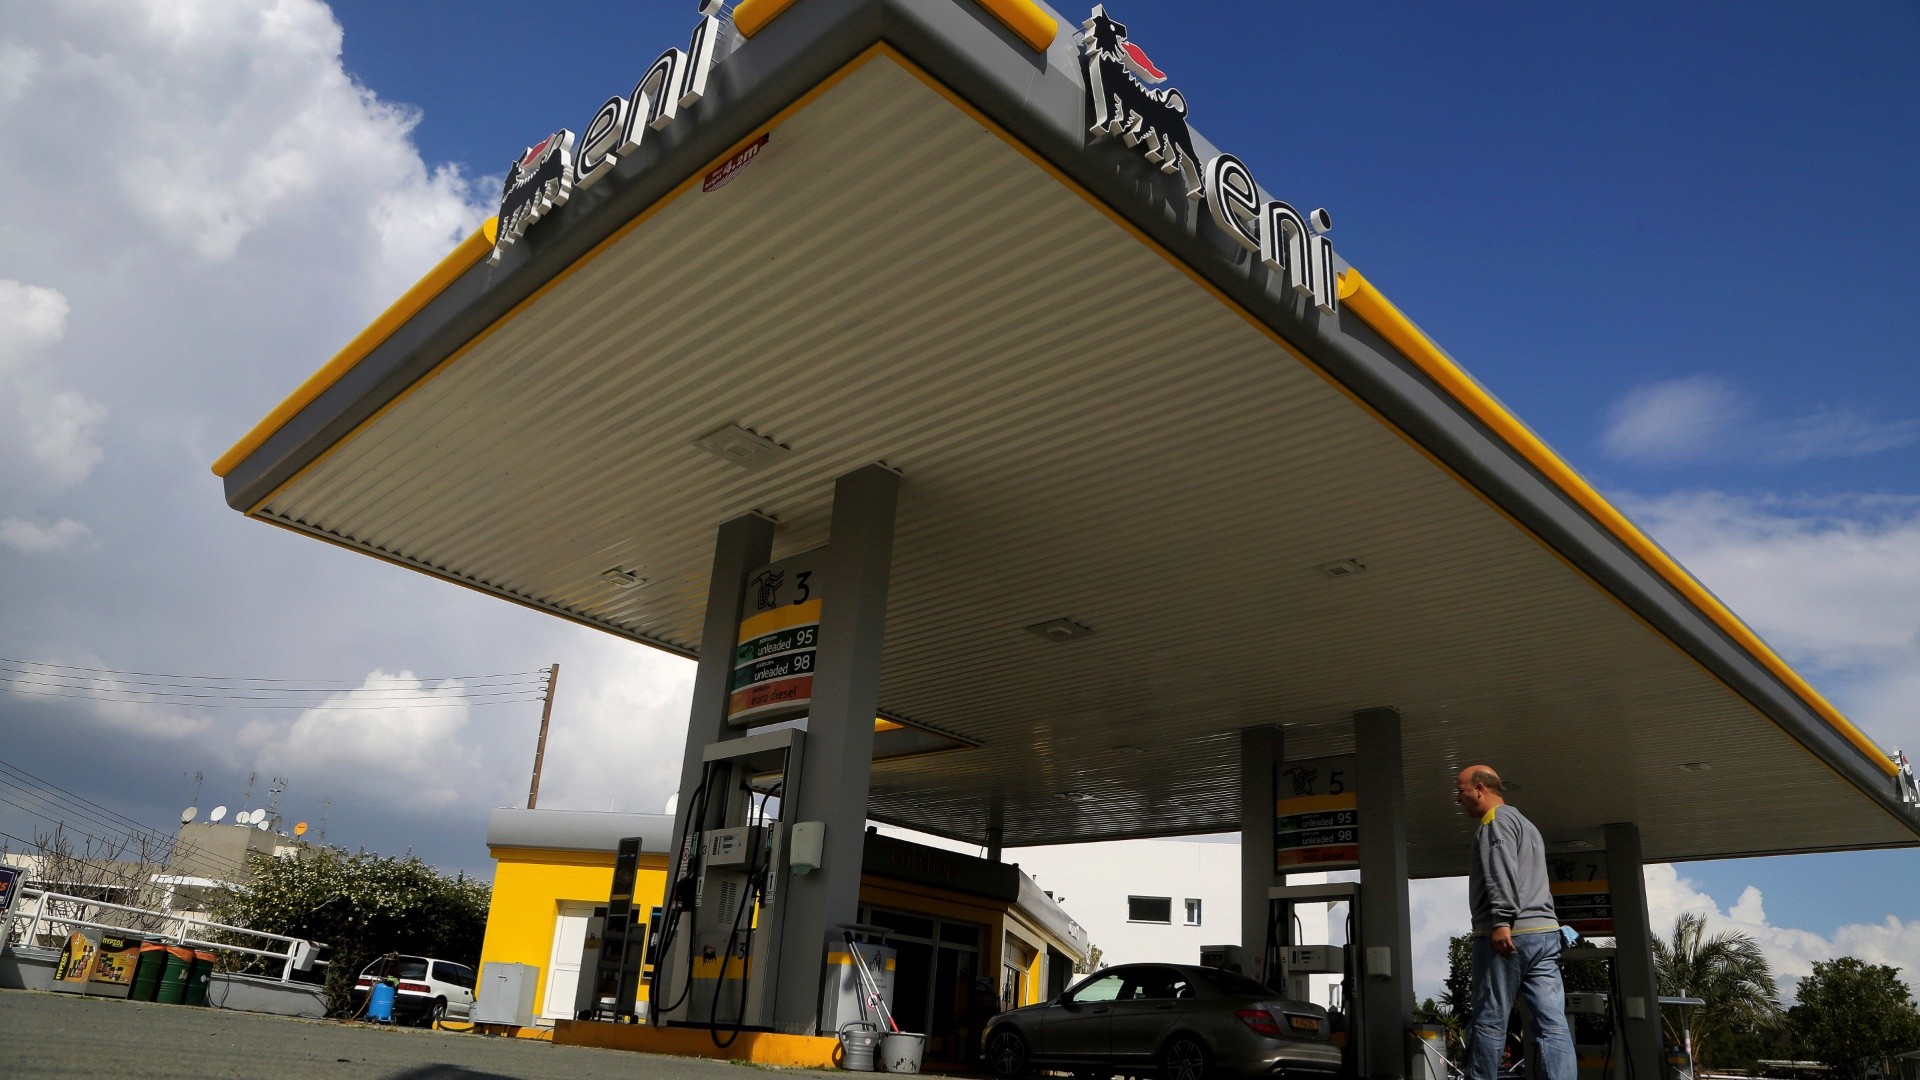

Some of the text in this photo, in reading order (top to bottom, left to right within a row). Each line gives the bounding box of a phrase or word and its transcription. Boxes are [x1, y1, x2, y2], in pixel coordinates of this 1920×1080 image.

[573, 0, 724, 190] eni
[1206, 152, 1336, 316] eni
[793, 569, 812, 606] 3
[757, 637, 792, 656] unleaded
[796, 629, 814, 646] 95
[754, 662, 789, 681] unleaded
[793, 654, 811, 671] 98
[770, 685, 797, 701] diesel
[1329, 771, 1344, 796] 5
[1301, 816, 1334, 828] unleaded
[1337, 812, 1353, 824] 95
[1301, 829, 1354, 845] unleaded 98
[1585, 864, 1598, 882] 7
[1593, 895, 1607, 904] 95
[1595, 908, 1608, 918] 98
[739, 942, 747, 959] 3
